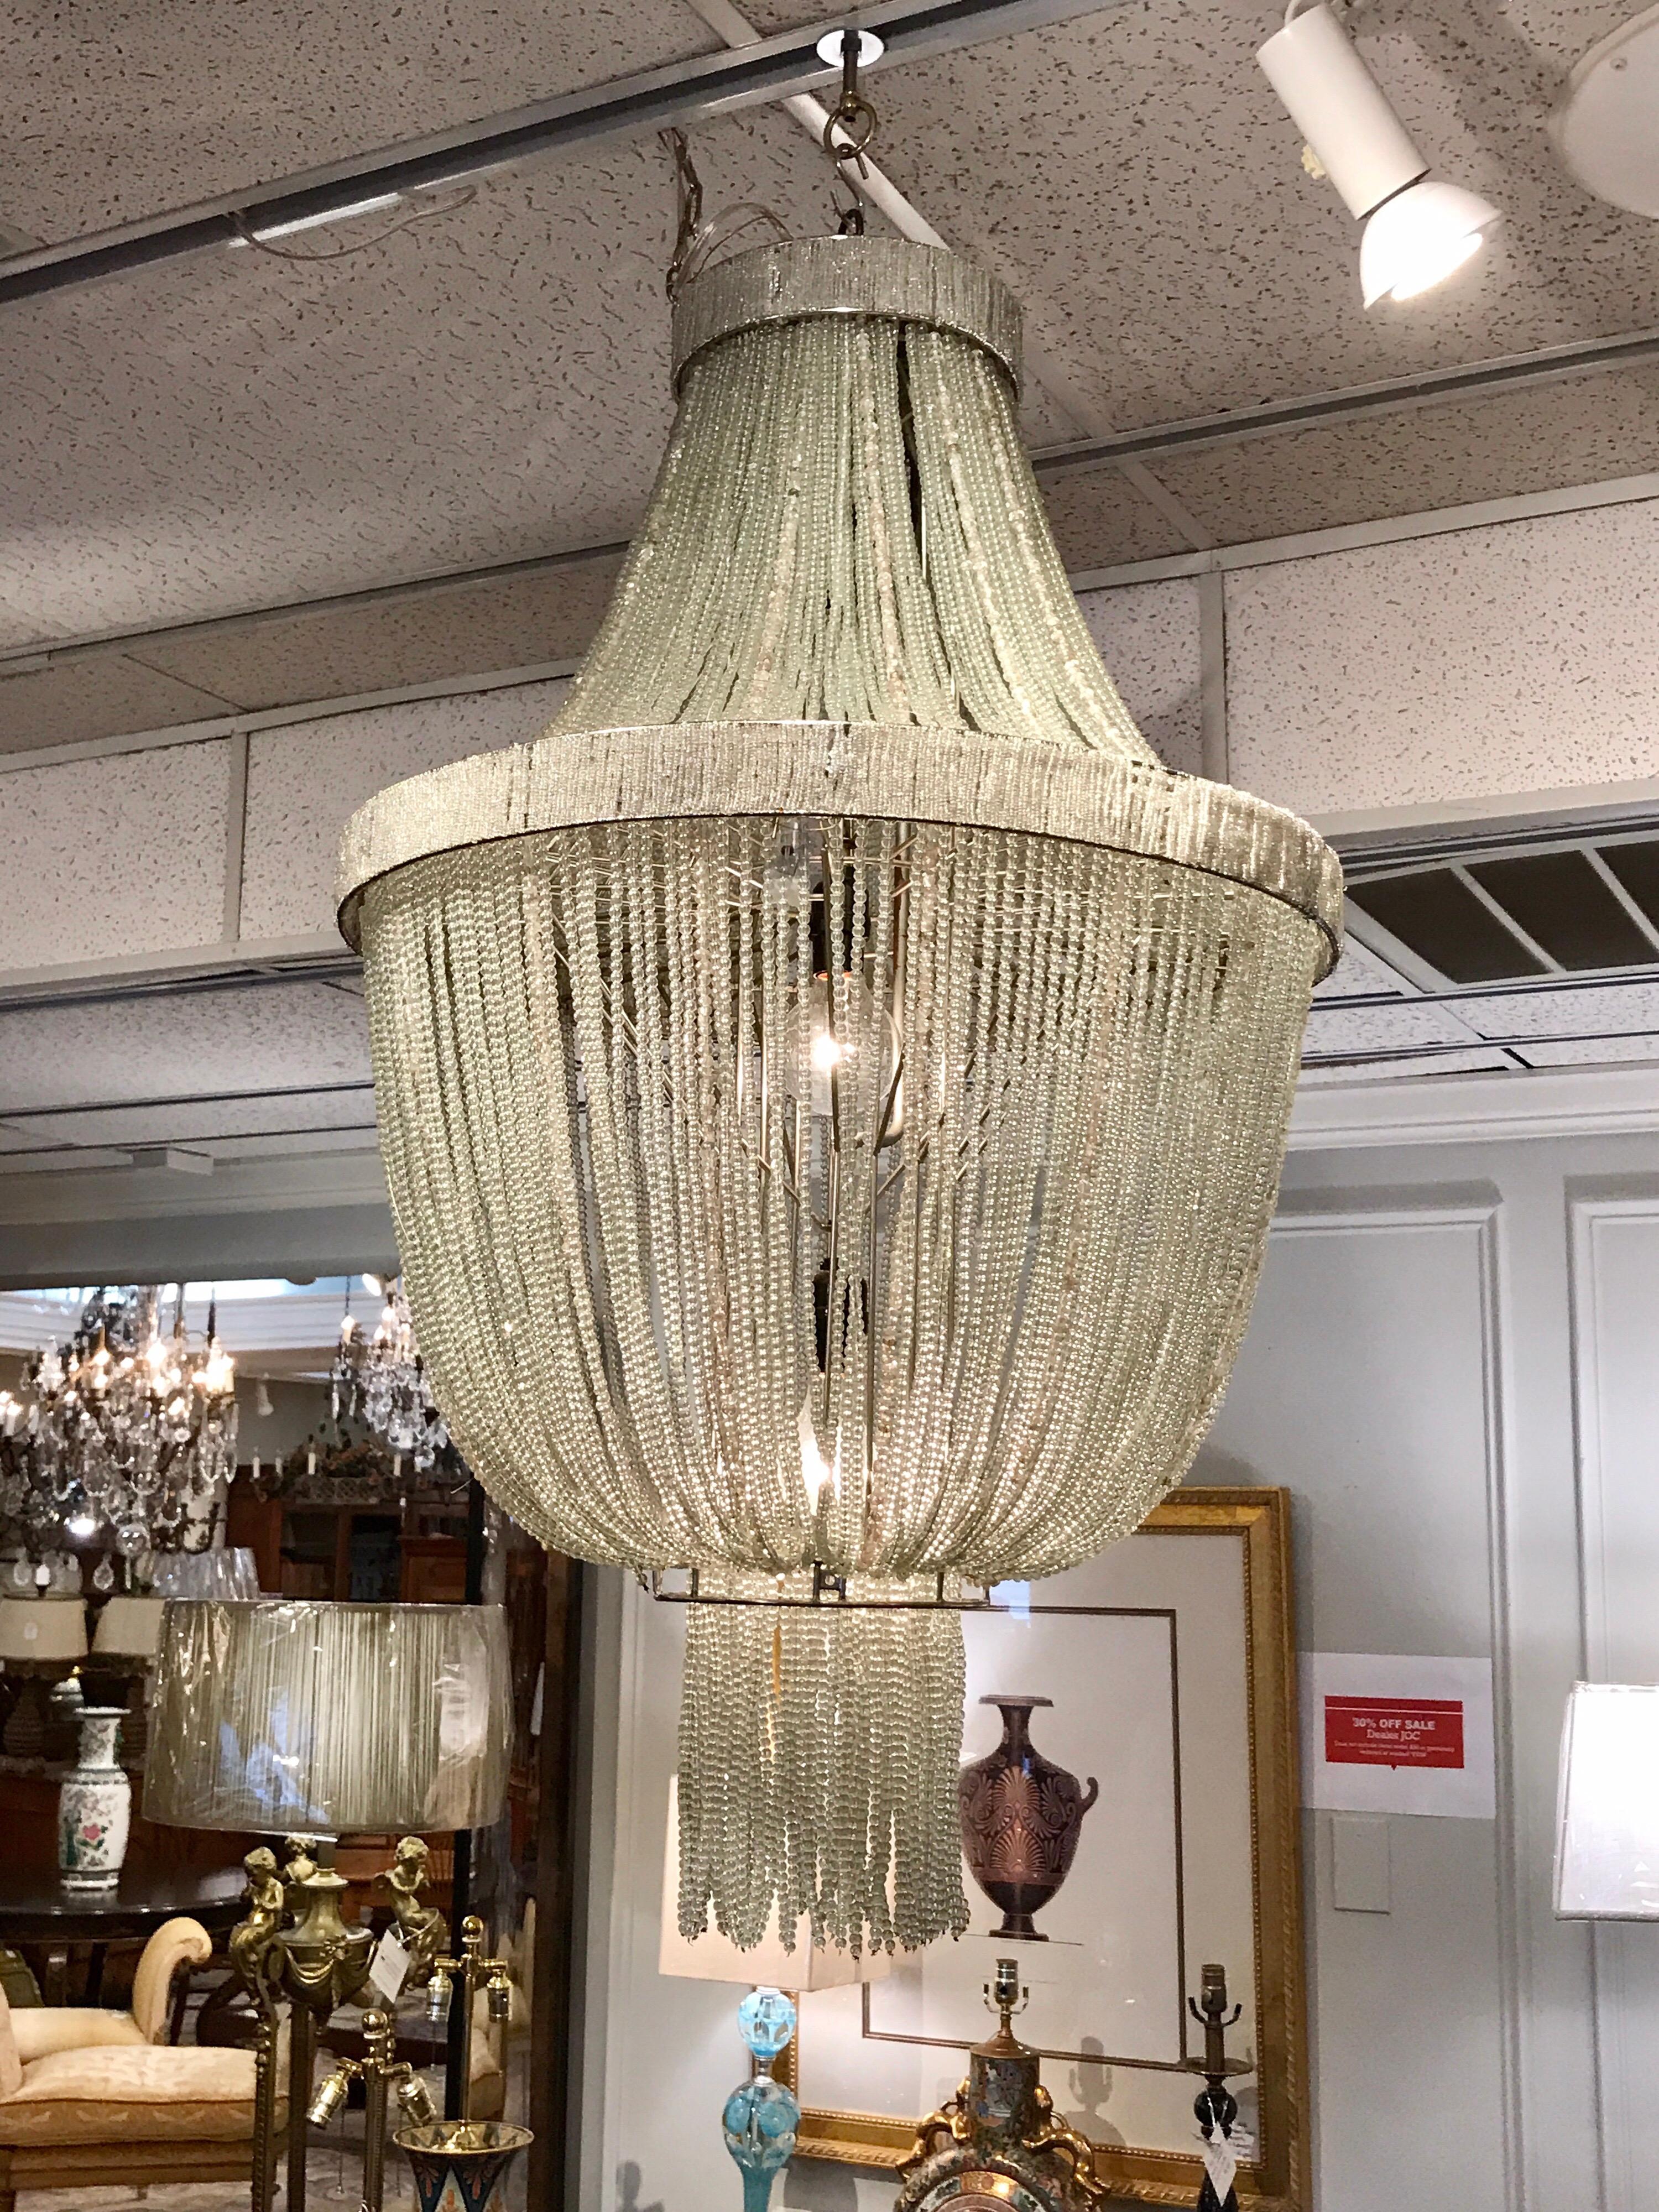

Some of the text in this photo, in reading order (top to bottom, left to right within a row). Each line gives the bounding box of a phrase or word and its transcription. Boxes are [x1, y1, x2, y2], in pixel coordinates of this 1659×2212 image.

[1352, 1717, 1436, 1730] 30% OFF SALE
